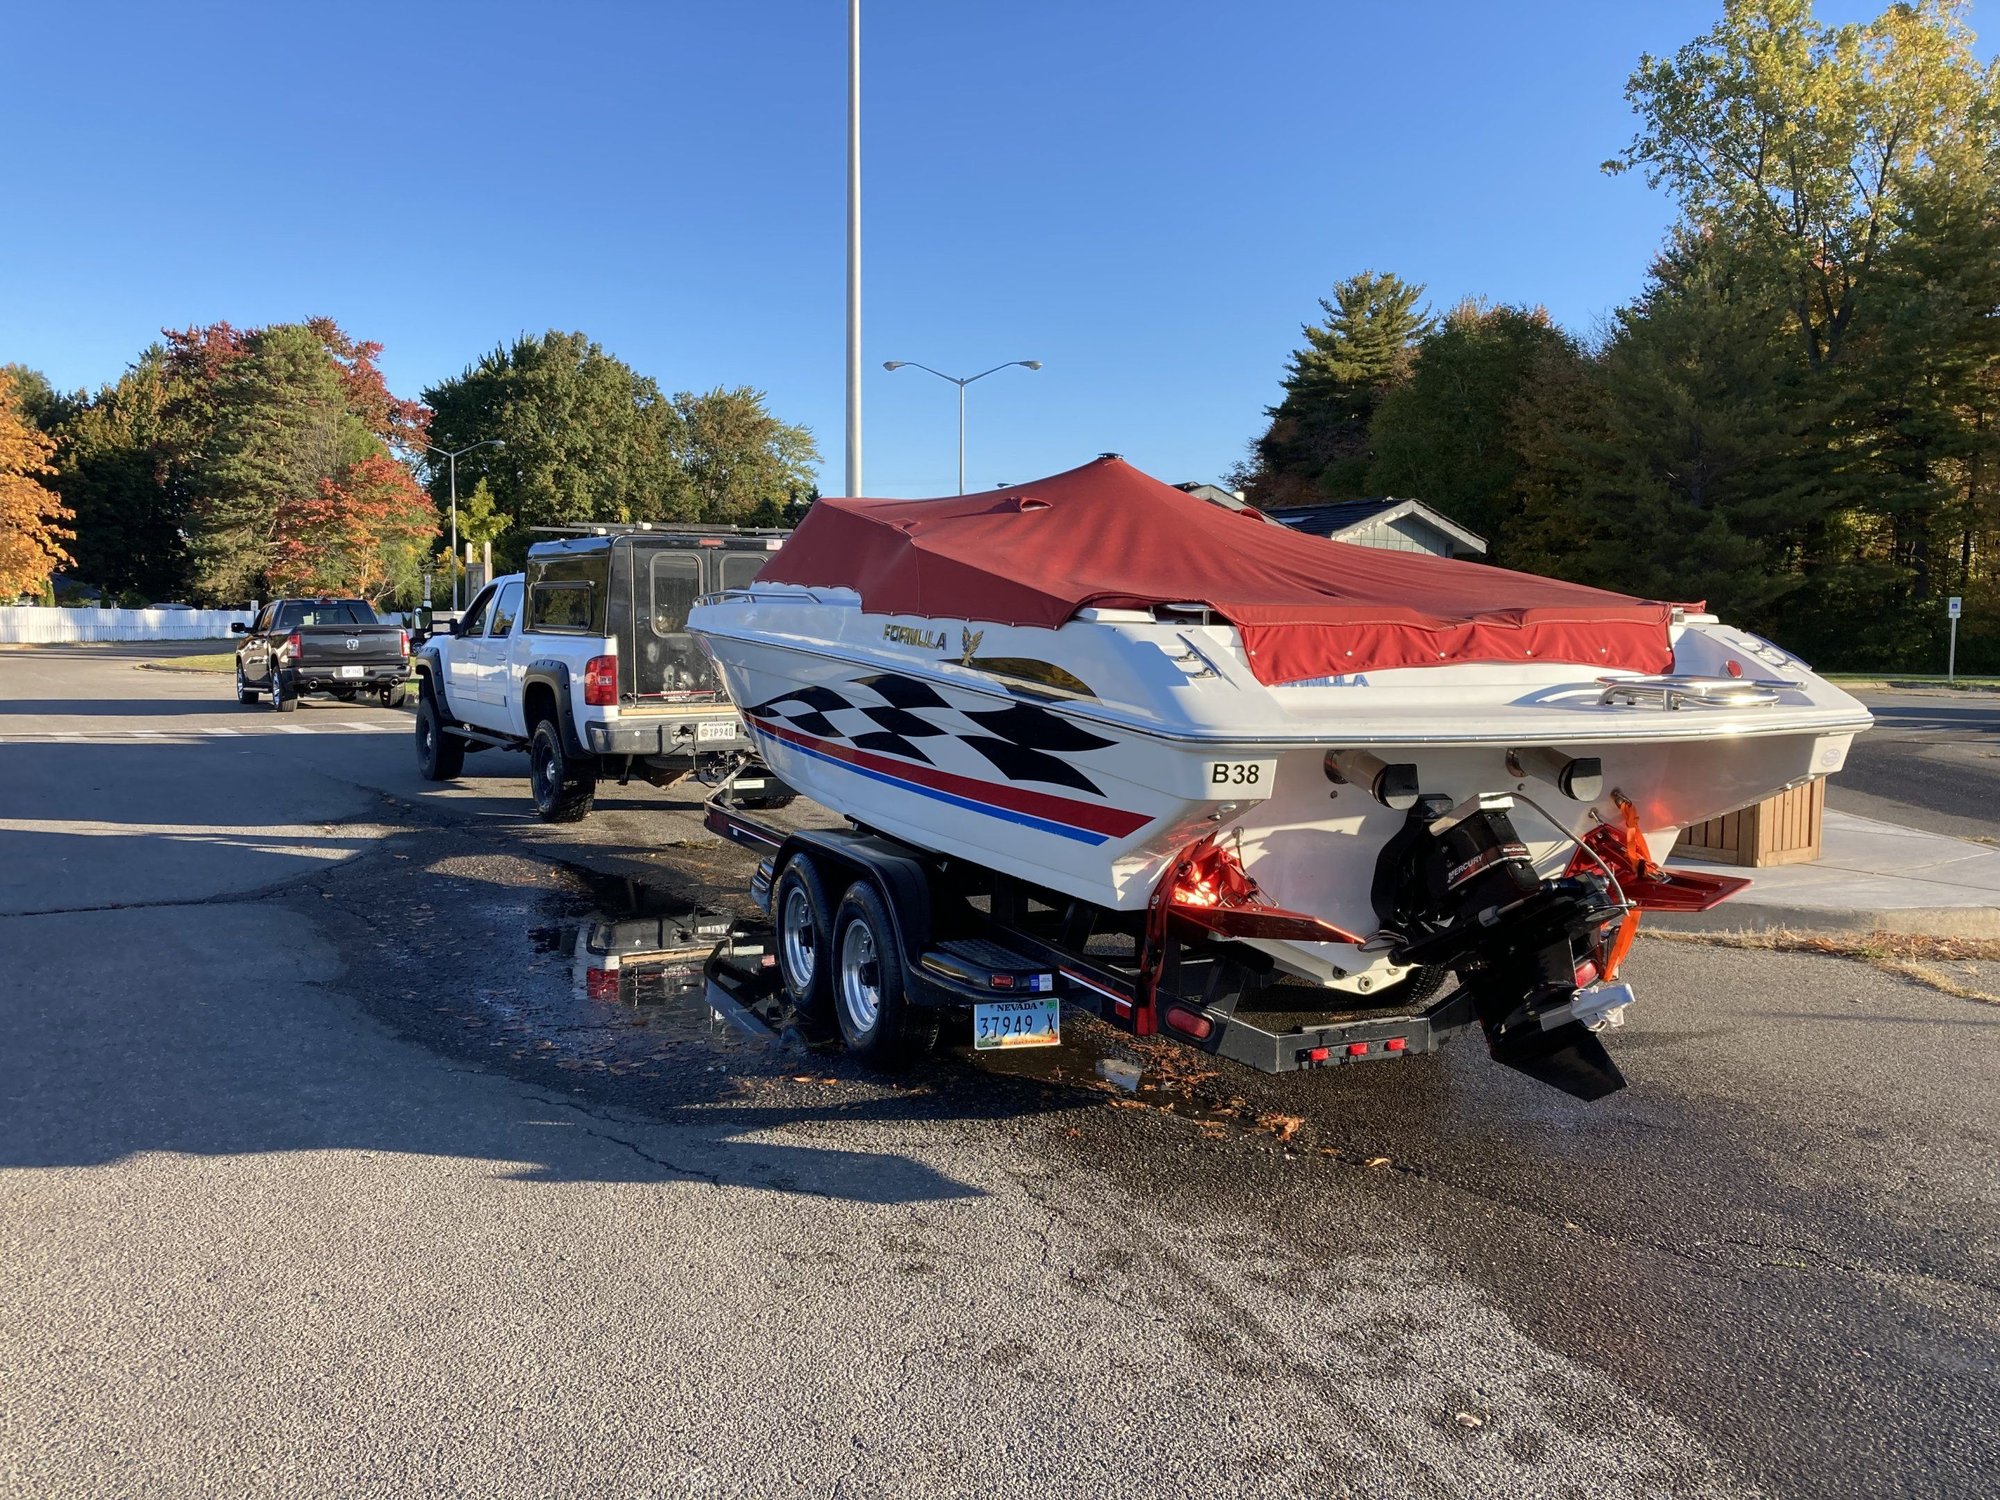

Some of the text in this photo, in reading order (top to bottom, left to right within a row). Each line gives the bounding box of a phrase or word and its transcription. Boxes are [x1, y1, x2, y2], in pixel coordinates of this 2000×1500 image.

[883, 623, 946, 650] FORMULA
[1212, 763, 1260, 784] B38
[1447, 853, 1483, 882] MERCURY
[997, 1002, 1038, 1012] NEVADA
[980, 1013, 1055, 1039] 37949 X
